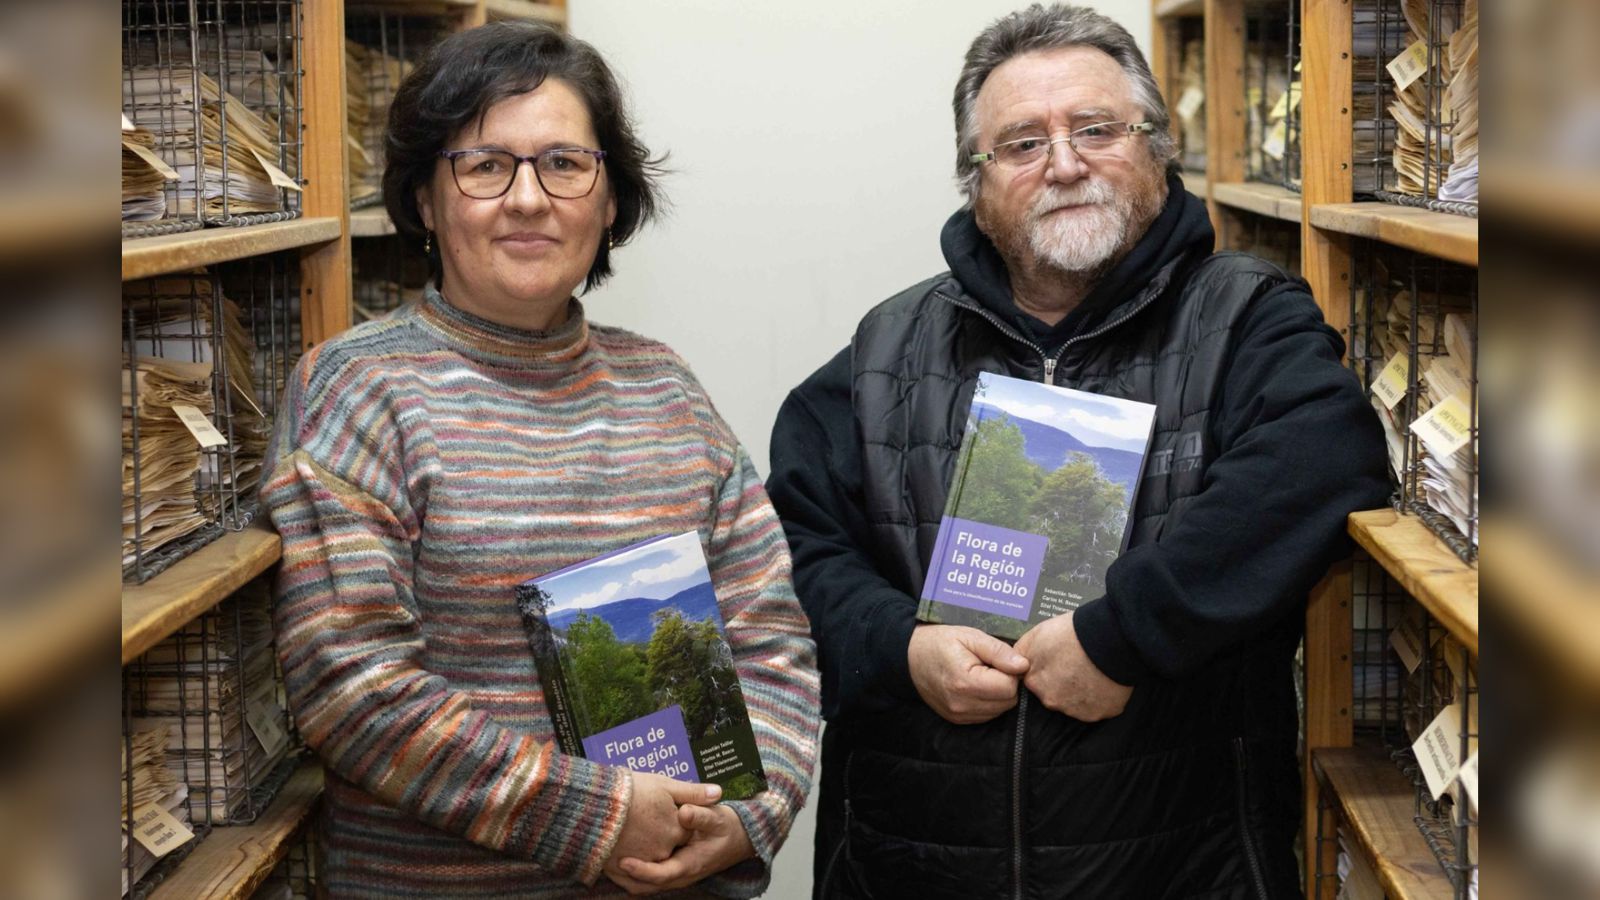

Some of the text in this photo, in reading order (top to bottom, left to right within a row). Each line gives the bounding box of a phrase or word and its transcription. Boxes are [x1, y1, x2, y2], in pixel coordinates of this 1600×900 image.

[957, 531, 1023, 557] Flora de
[951, 549, 1026, 578] la Región
[947, 568, 973, 585] del
[976, 573, 1028, 598] Biobío
[605, 727, 666, 759] Flora de
[622, 745, 678, 770] Región
